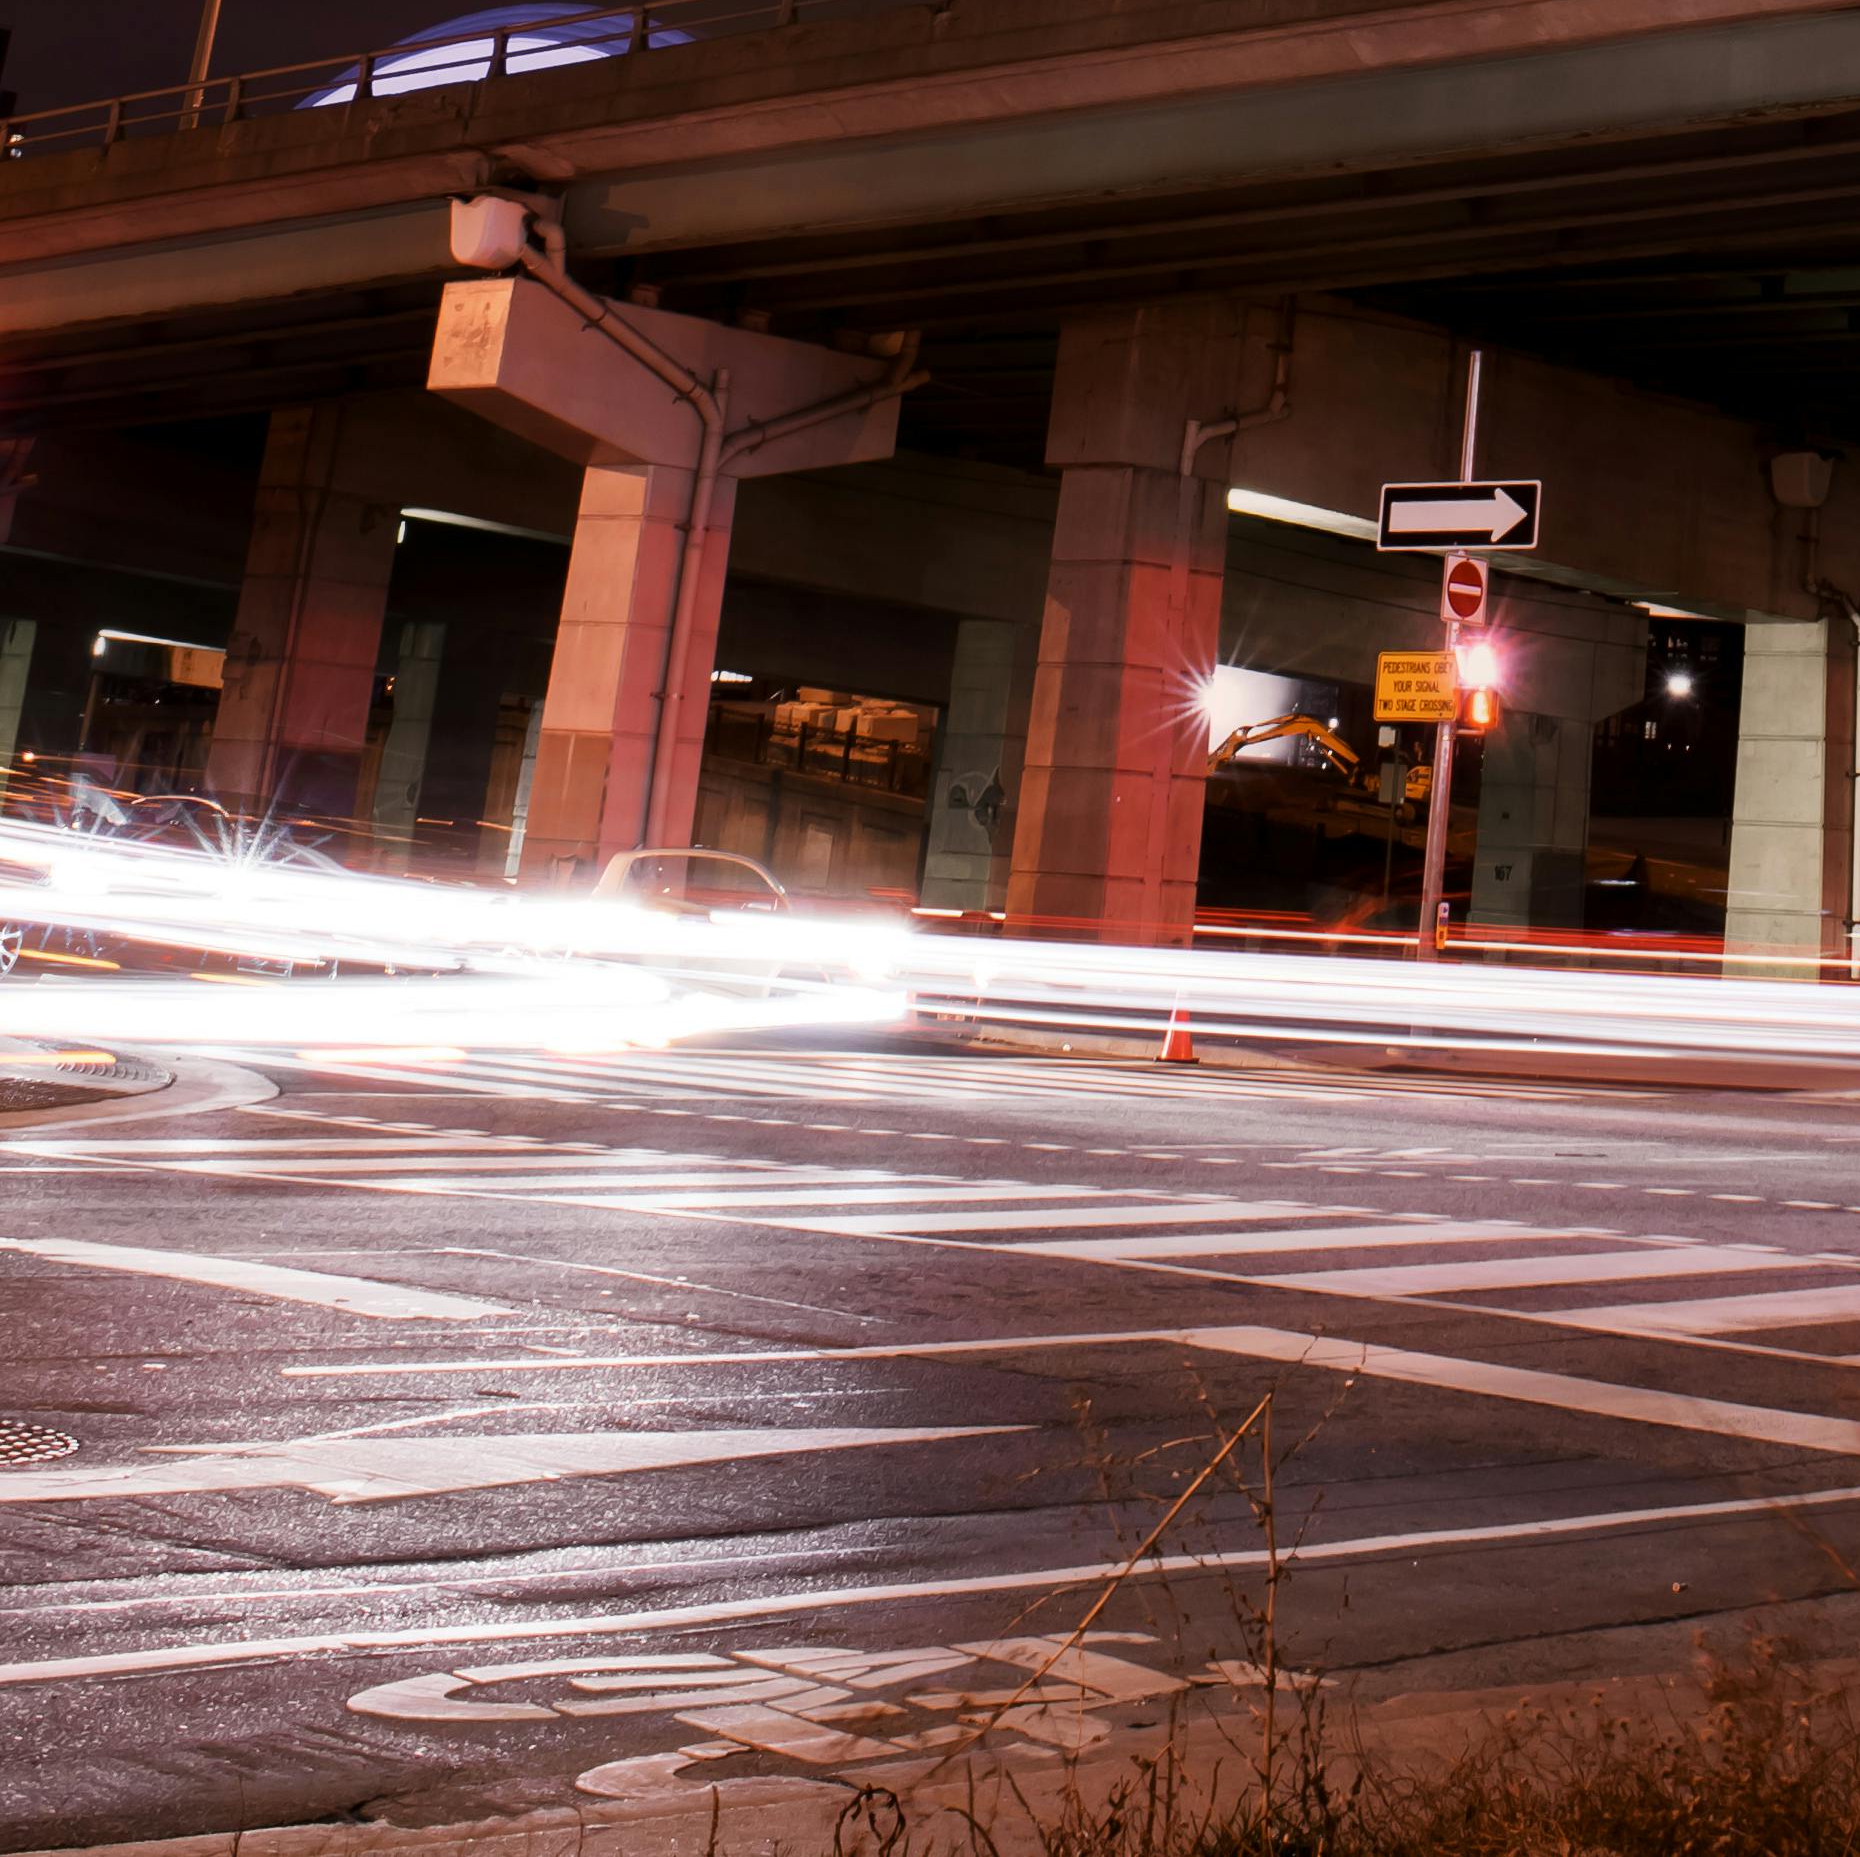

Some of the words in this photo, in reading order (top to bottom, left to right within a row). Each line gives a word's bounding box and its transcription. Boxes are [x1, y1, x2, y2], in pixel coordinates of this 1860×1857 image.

[1382, 661, 1431, 674] PEDESTRIANS
[1393, 680, 1413, 693] YOUR
[1415, 680, 1440, 693] SIGNAL
[1378, 699, 1394, 712] TWO
[1395, 699, 1417, 712] STAGE
[1419, 699, 1454, 712] CROSSING
